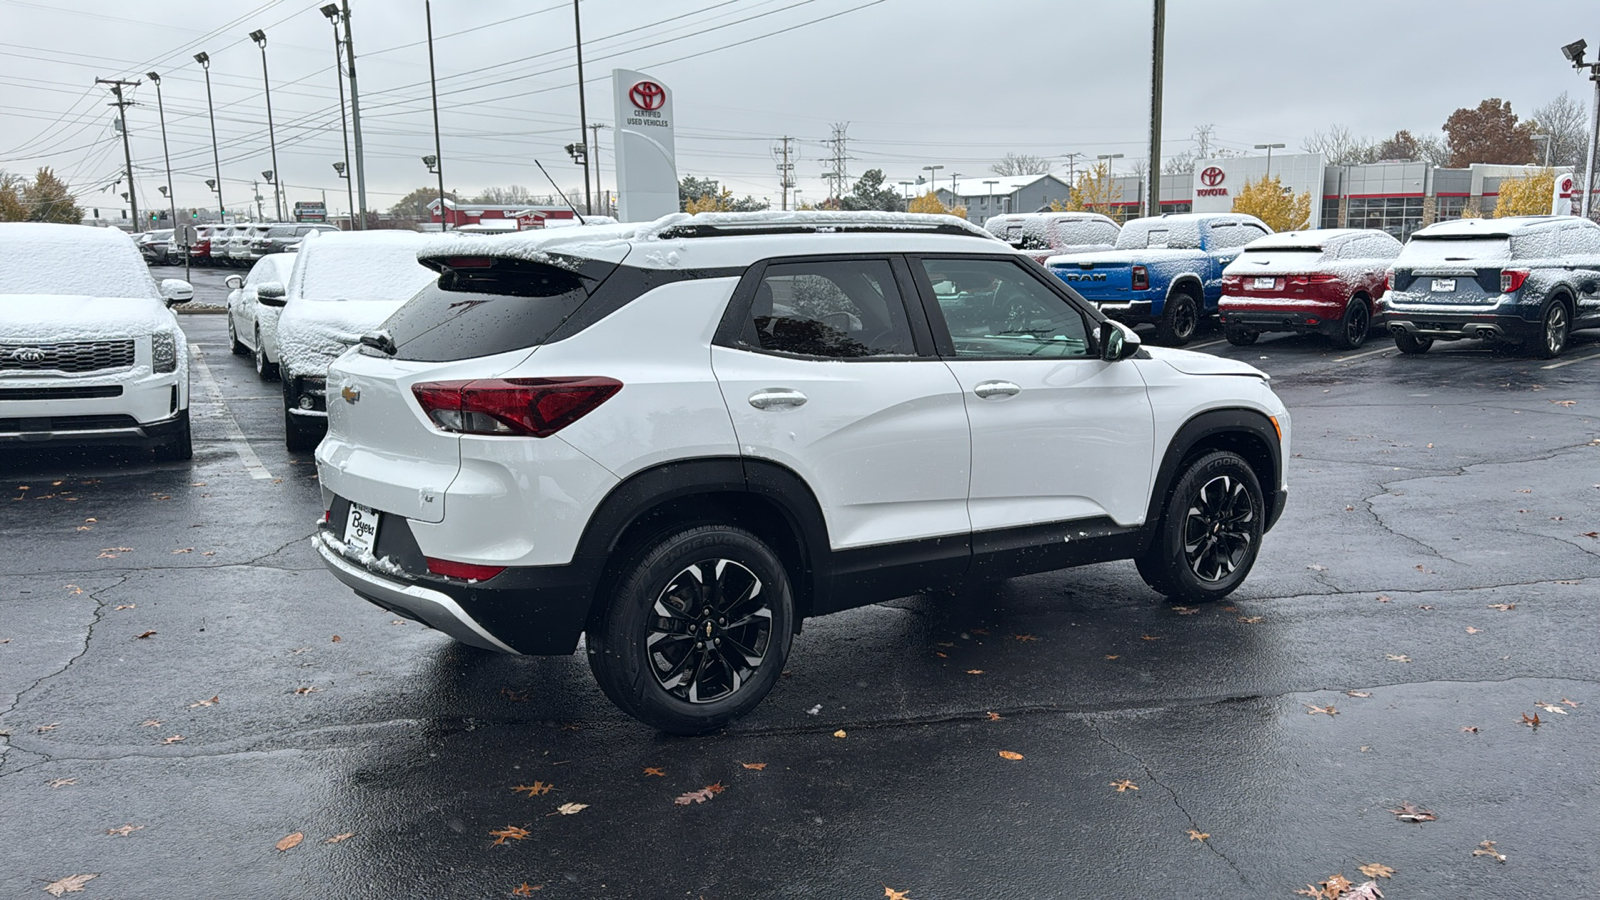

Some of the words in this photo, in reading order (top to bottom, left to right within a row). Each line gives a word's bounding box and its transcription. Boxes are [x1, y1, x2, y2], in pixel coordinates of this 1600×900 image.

[634, 110, 661, 118] CERTIFIED
[644, 119, 668, 127] VEHICLES
[1196, 188, 1228, 197] TOYOTA
[1066, 274, 1107, 282] RAM
[20, 352, 40, 360] KIA
[352, 510, 375, 537] Byers
